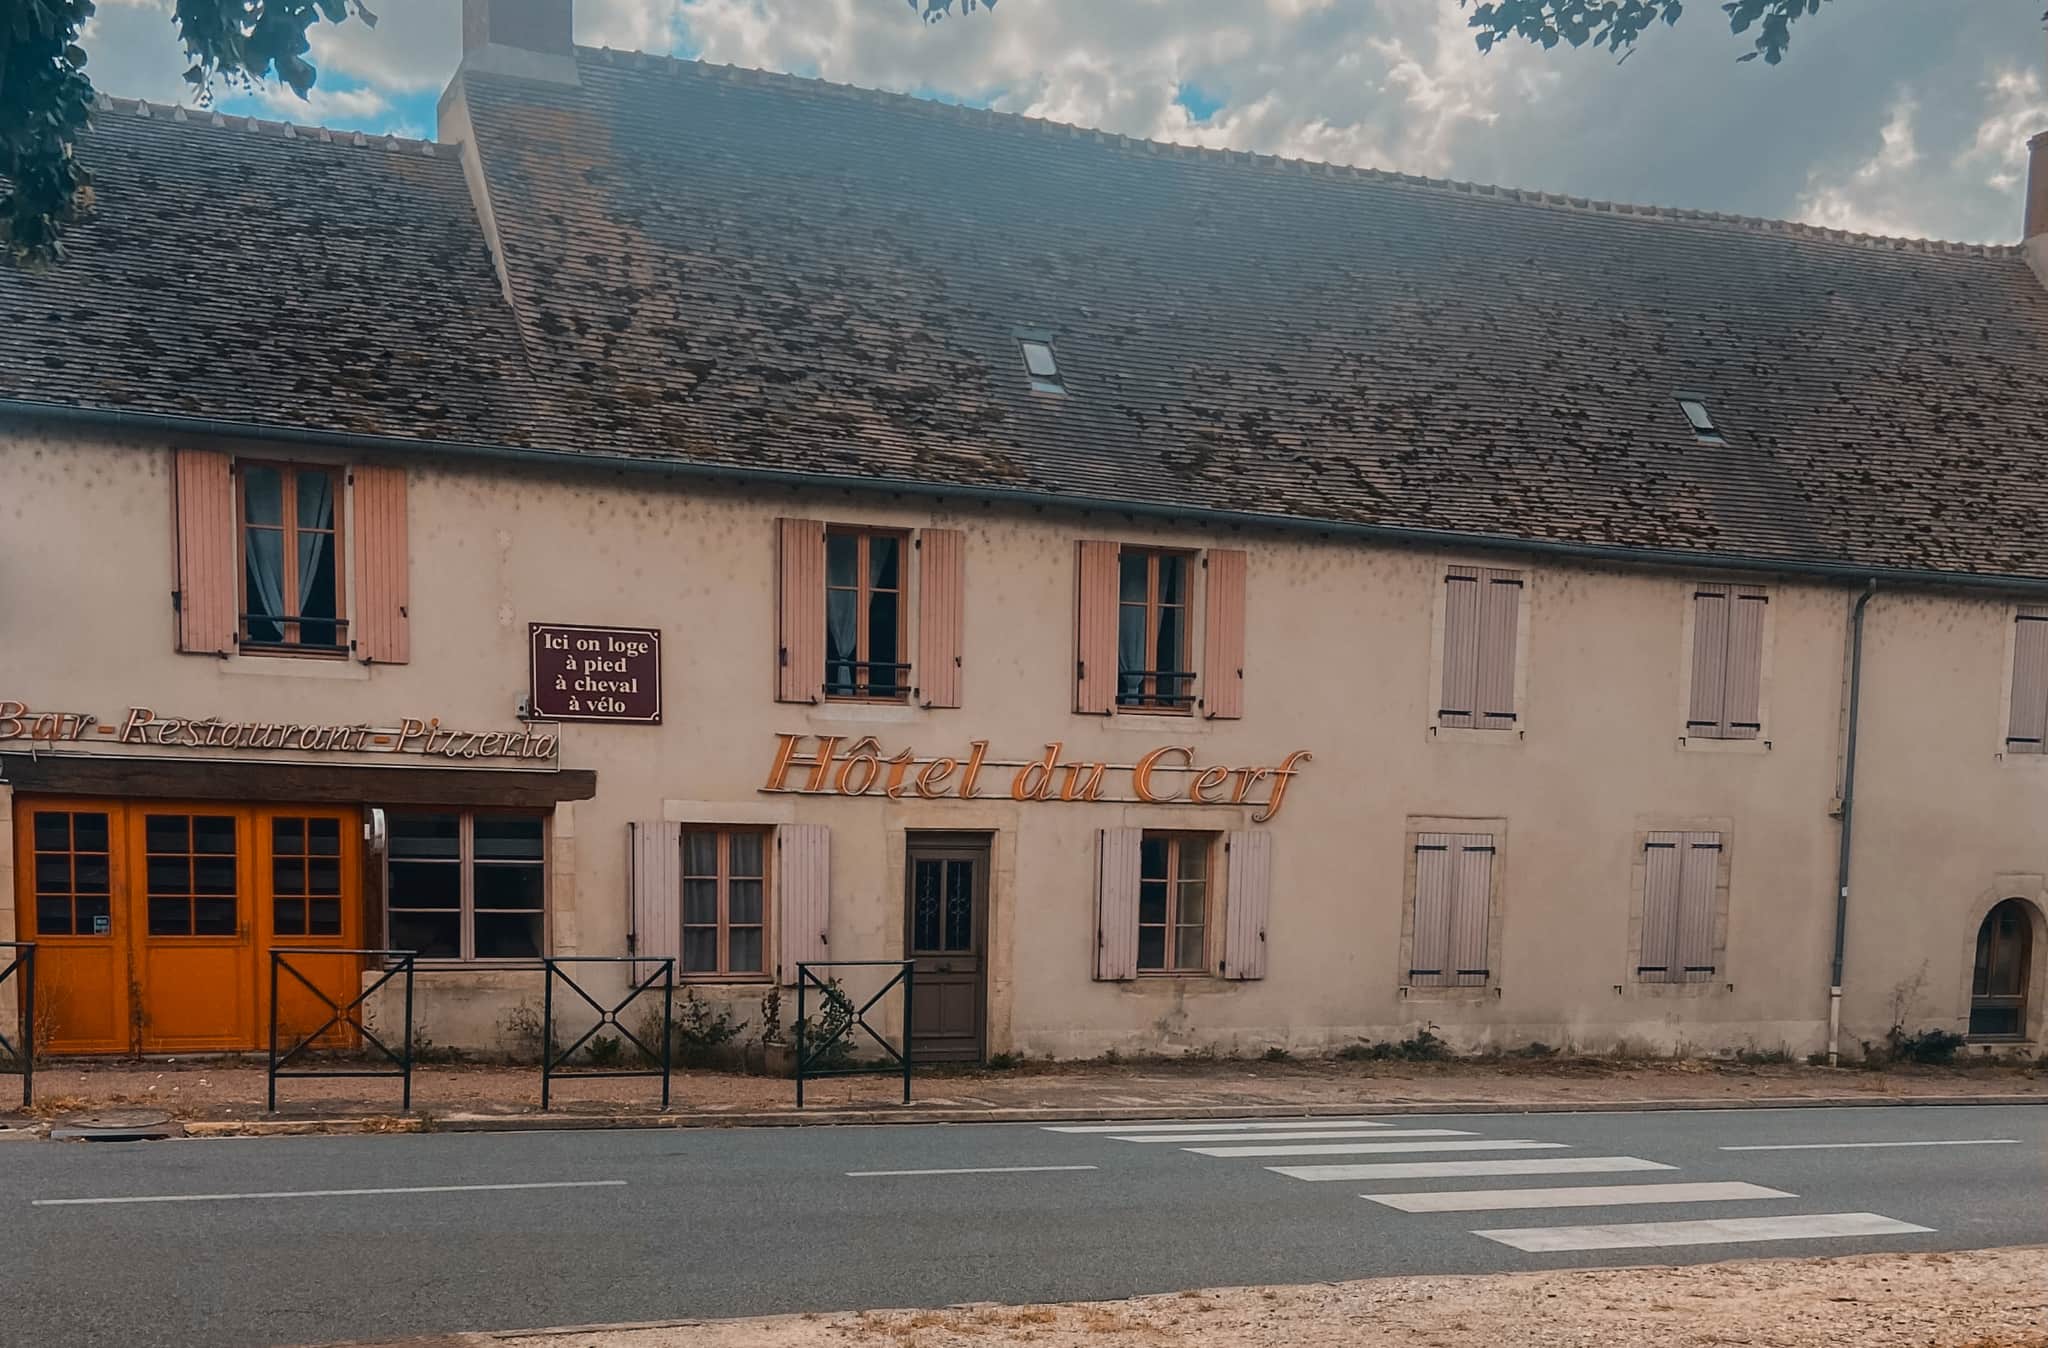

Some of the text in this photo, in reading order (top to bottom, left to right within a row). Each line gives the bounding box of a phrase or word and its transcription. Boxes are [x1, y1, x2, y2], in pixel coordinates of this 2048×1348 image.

[544, 633, 649, 657] Ici on loge
[566, 655, 627, 675] à pied
[555, 674, 638, 693] à cheval
[569, 696, 626, 713] à vélo
[757, 732, 1313, 823] Hôtel du Cerf
